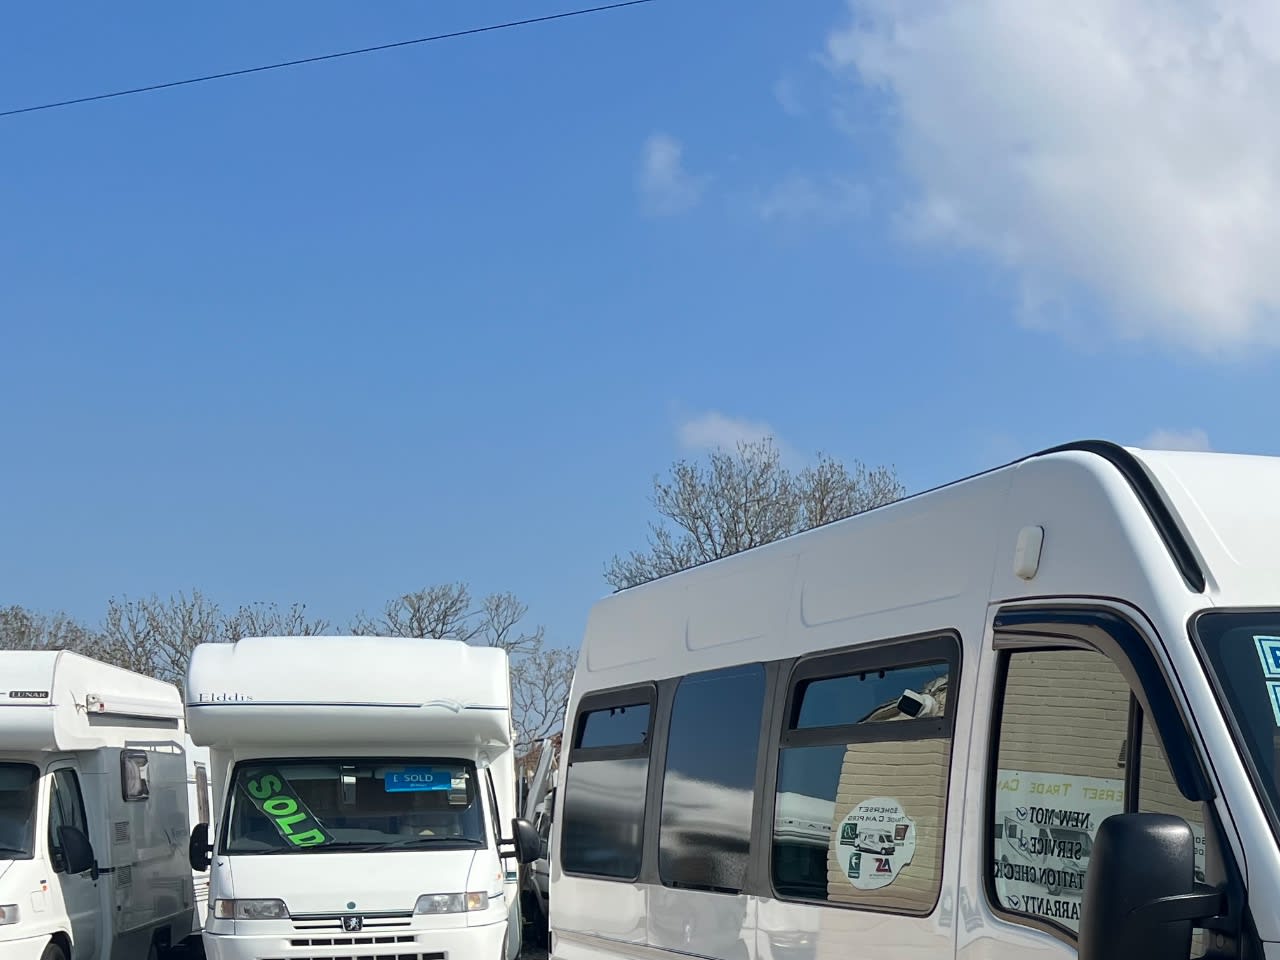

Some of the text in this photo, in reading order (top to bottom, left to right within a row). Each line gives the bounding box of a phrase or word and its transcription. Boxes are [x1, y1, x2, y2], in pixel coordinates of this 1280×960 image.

[12, 690, 47, 698] LUNAR
[199, 692, 253, 702] Elddis
[404, 774, 433, 782] SOLD
[247, 774, 326, 847] SOLD
